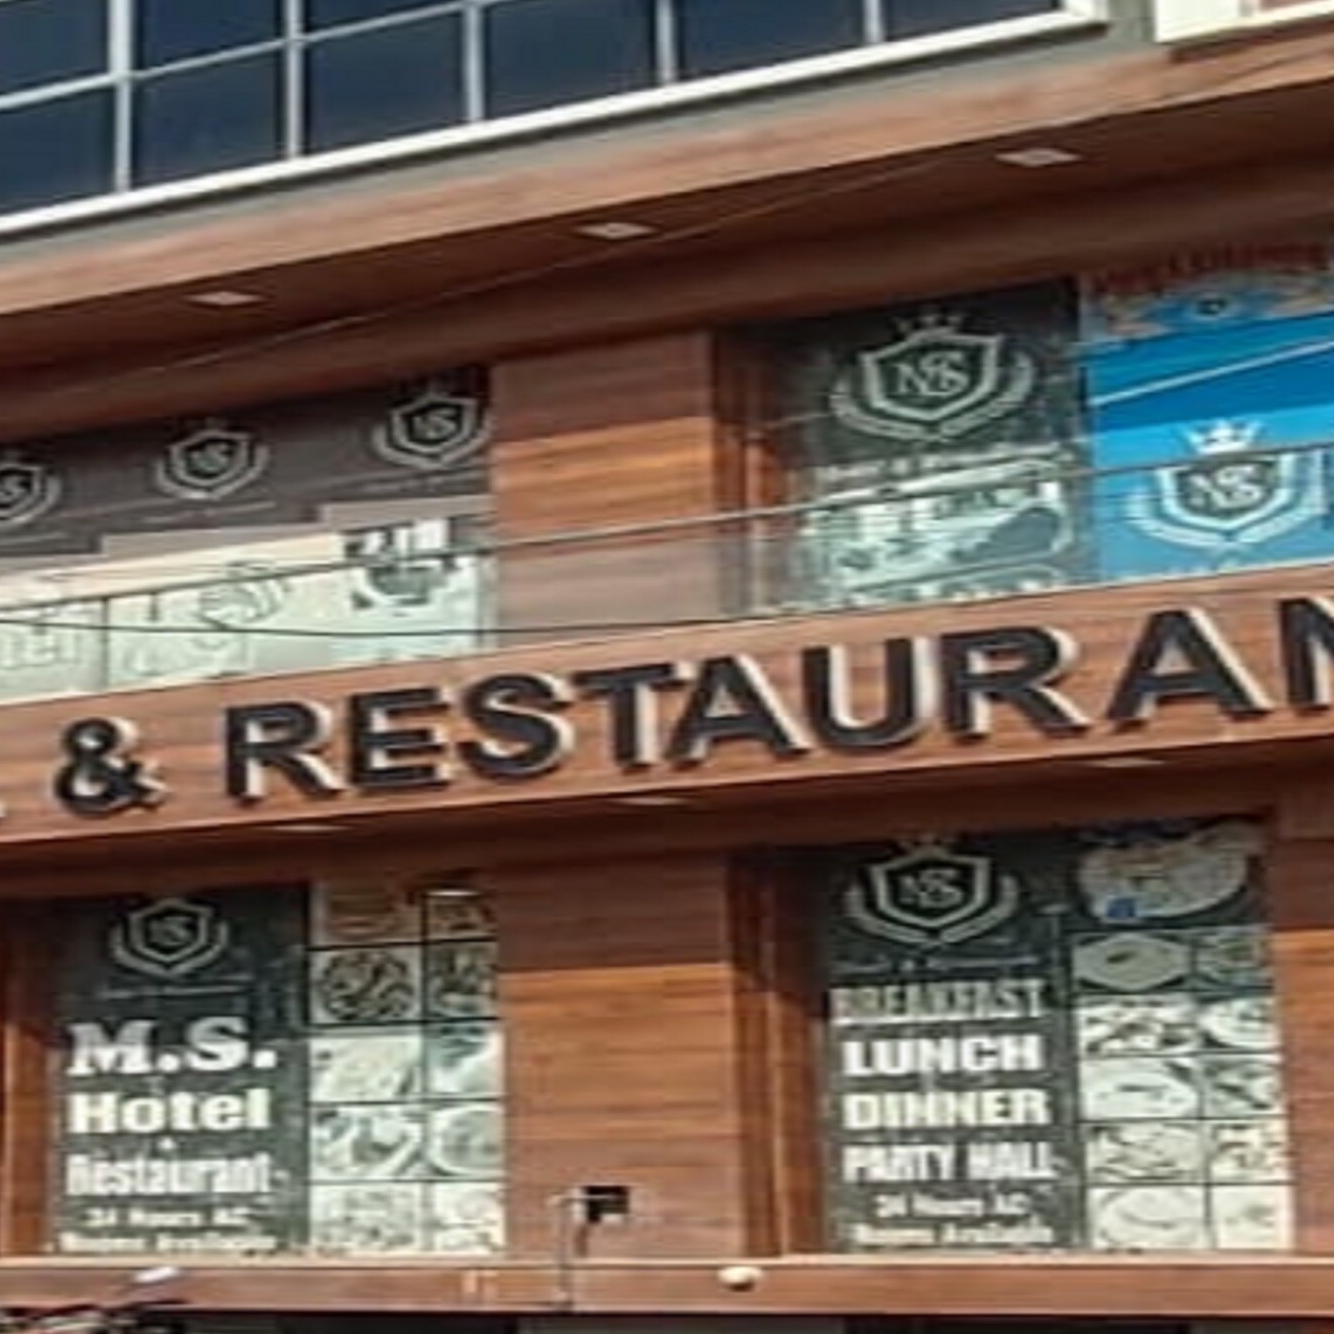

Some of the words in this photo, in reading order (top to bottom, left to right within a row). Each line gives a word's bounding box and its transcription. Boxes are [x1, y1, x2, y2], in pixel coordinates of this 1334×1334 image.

[54, 715, 163, 818] &
[830, 979, 1046, 1020] BREAKFAST
[68, 1016, 277, 1075] M.S.
[842, 1034, 1044, 1077] LUNCH
[70, 1088, 268, 1133] Hotel
[843, 1088, 1052, 1130] DINNER
[67, 1152, 268, 1195] Restaurant
[843, 1143, 955, 1181] PARTY
[967, 1142, 1058, 1180] HALL
